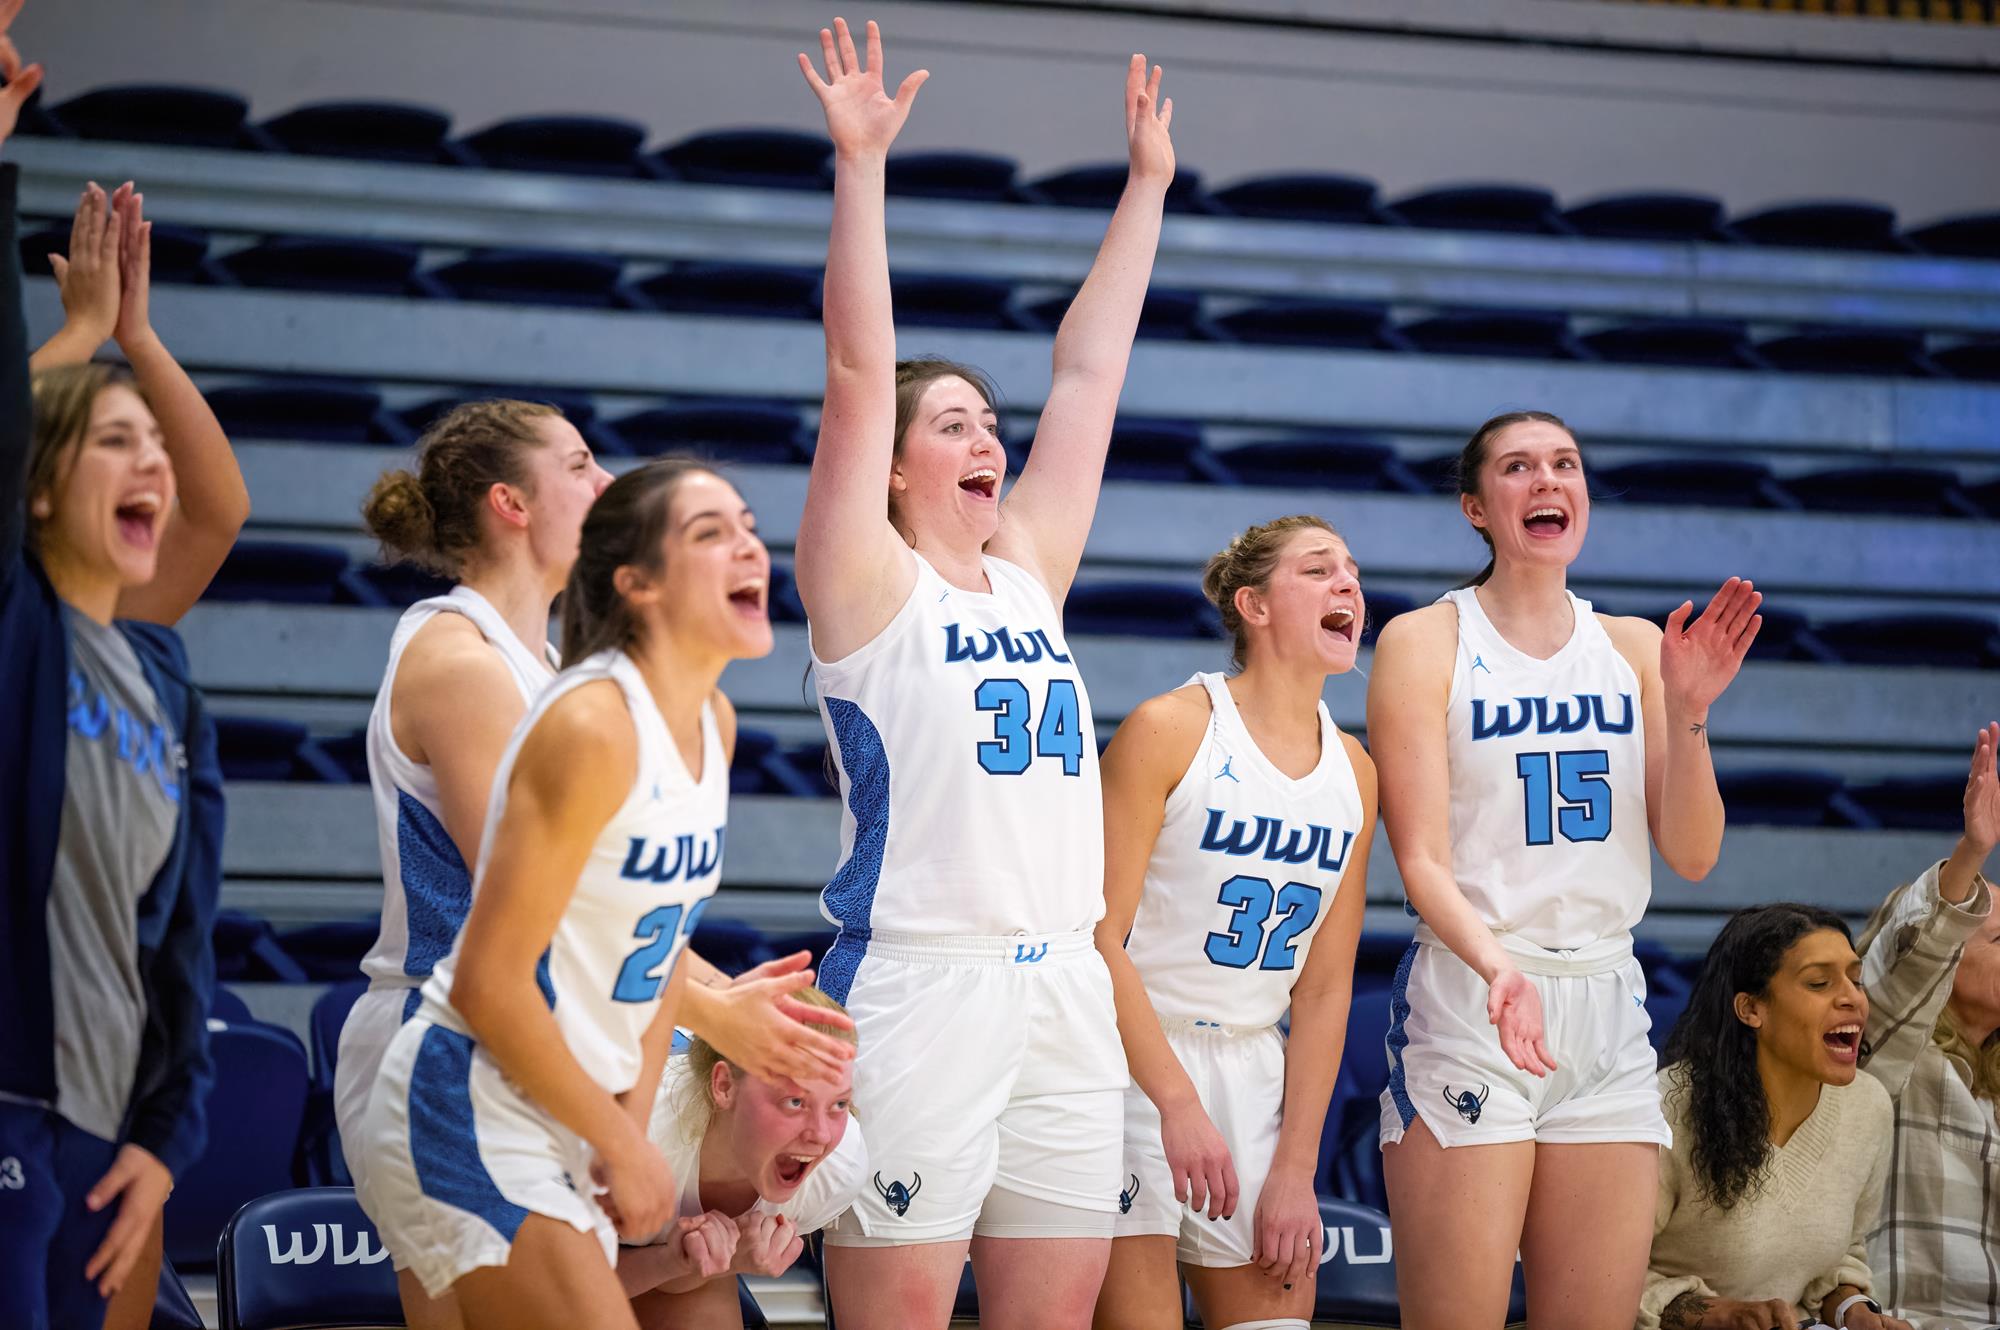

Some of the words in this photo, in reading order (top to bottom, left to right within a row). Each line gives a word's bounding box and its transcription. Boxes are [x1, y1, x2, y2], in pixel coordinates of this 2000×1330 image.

[975, 679, 1083, 777] 34
[1470, 693, 1633, 741] WWU
[1516, 750, 1612, 846] 15
[620, 827, 725, 883] WW
[1199, 807, 1354, 872] WWU
[612, 898, 710, 1003] 2
[1204, 874, 1322, 970] 32
[0, 1156, 25, 1189] 3
[261, 1224, 390, 1265] WW
